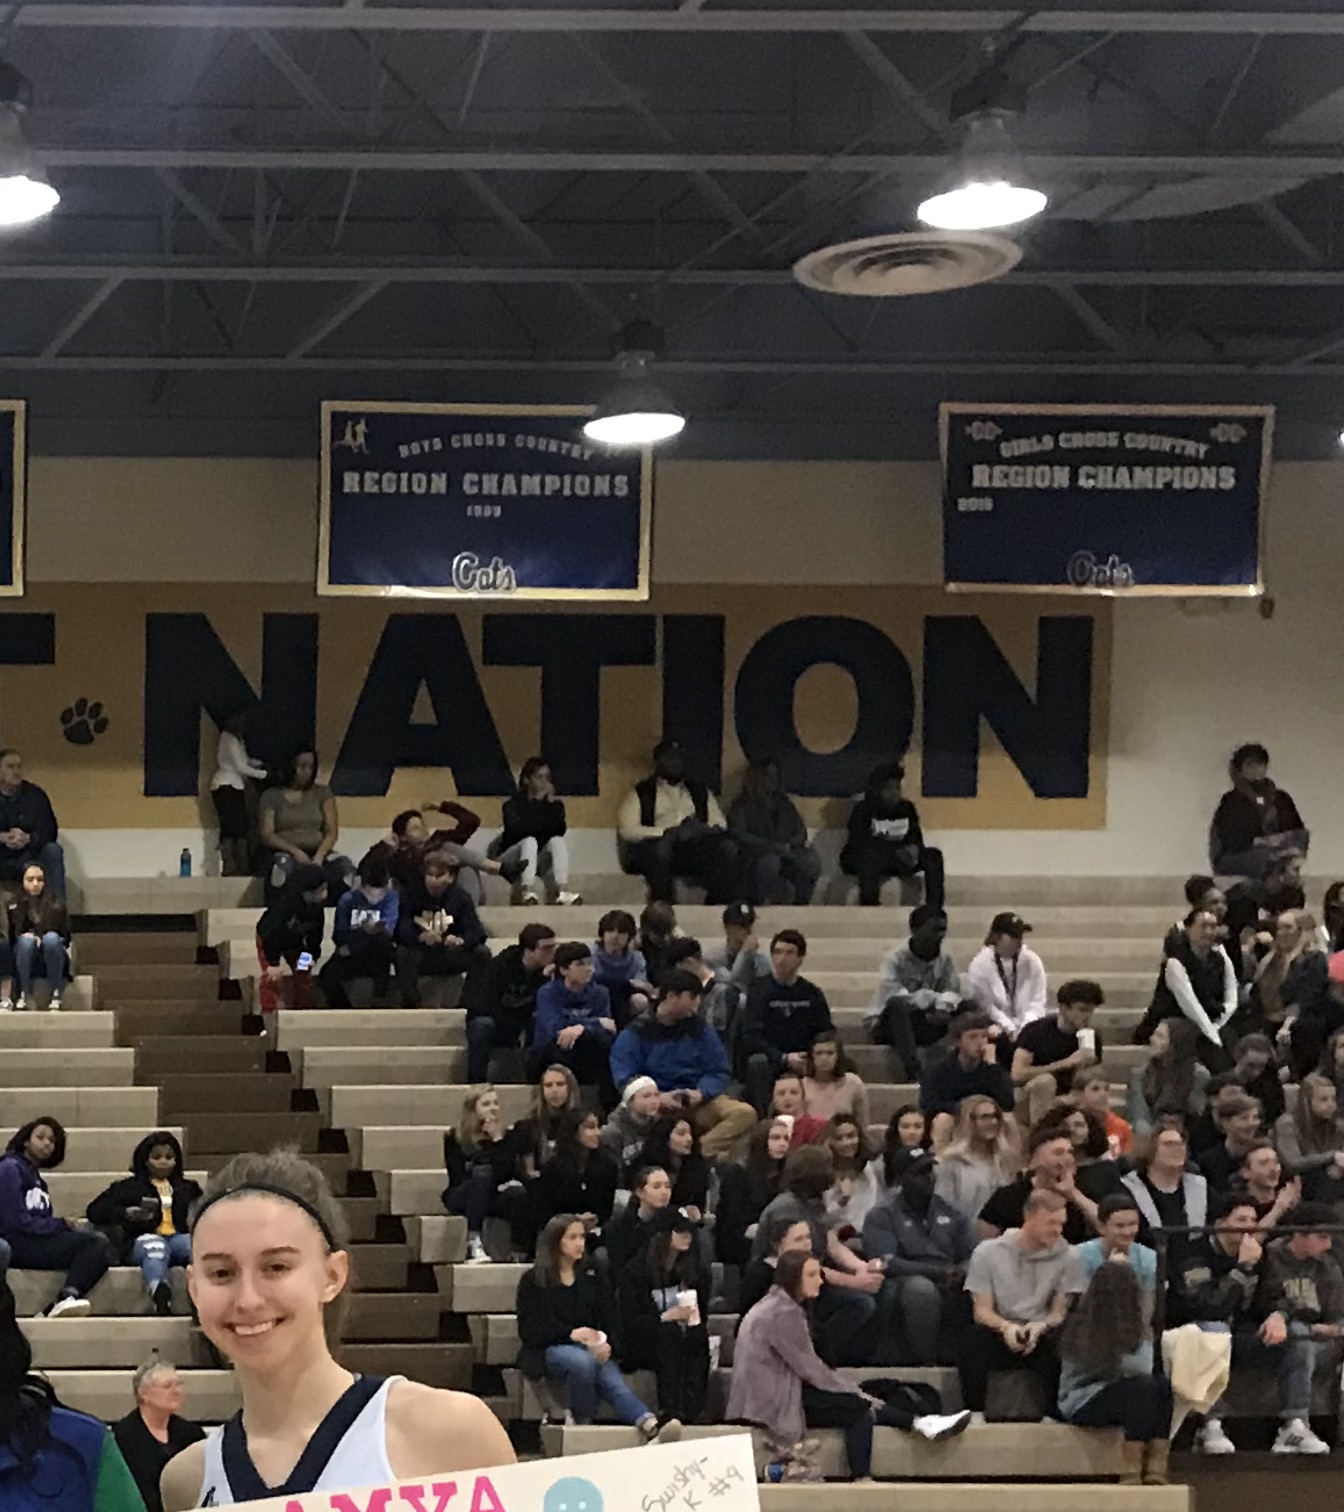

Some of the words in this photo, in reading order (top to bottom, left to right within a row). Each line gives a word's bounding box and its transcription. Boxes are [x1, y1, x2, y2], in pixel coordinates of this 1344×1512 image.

[398, 437, 443, 459] BOYS
[451, 432, 507, 449] CROSS
[999, 434, 1054, 458] GIRLS
[1058, 430, 1121, 449] CROSS
[1123, 431, 1209, 460] COUNTRY
[343, 471, 448, 495] REGION
[463, 472, 629, 497] CHAMPIONS
[972, 464, 1070, 489] REGION
[1077, 465, 1236, 490] CHAMPIONS
[451, 551, 517, 594] Cats
[143, 612, 1094, 800] NATION
[682, 1490, 704, 1512] K
